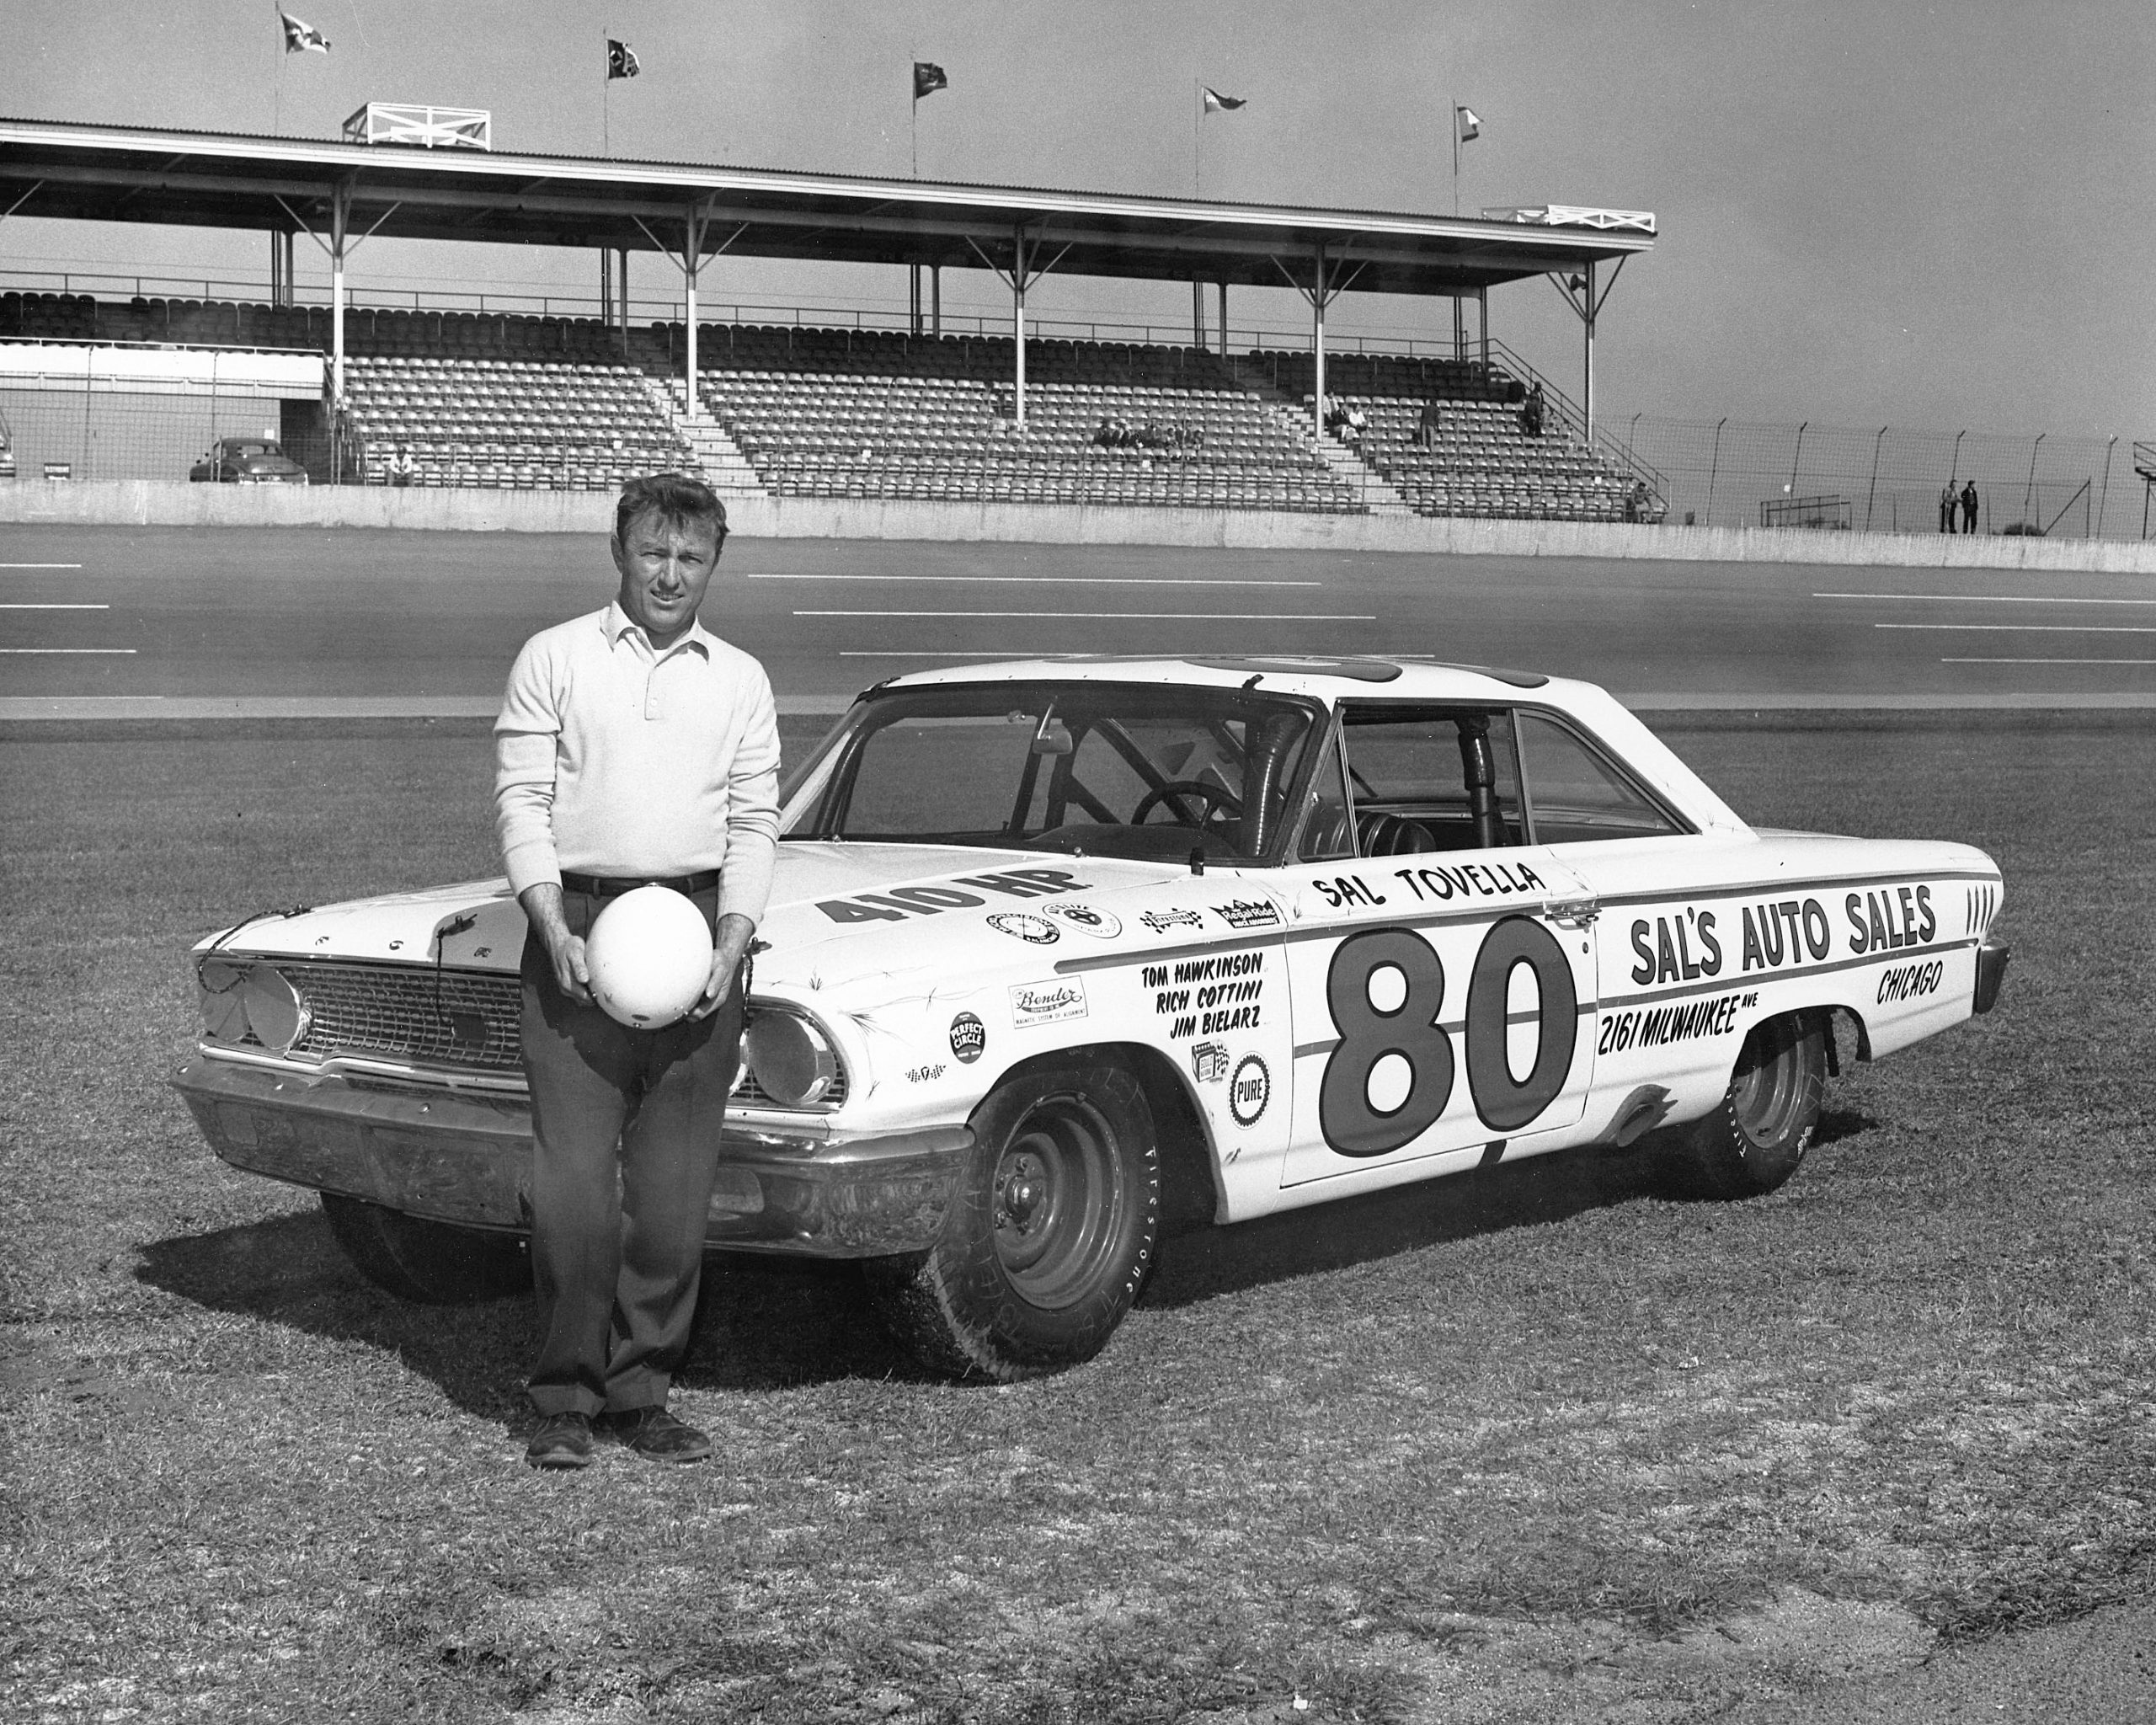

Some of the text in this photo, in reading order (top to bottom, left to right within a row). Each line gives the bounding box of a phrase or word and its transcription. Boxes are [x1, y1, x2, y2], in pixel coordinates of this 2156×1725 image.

[1312, 862, 1547, 908] SAL TOVELLA
[814, 886, 986, 923] 410
[1630, 884, 1936, 985] SAL'S AUTO SALES
[1141, 951, 1263, 989] TOM HAWKINSON
[1876, 959, 1944, 1005] CHICAGO
[1155, 979, 1263, 1015] RICH COTTINI
[949, 1023, 984, 1040] PERFECT
[953, 1033, 982, 1049] CIRCLE
[1170, 1005, 1261, 1039] JIM BIELARZ
[1319, 913, 1578, 1158] 80
[1598, 991, 1759, 1055] 2161 MILWAUKEE AVE
[1236, 1078, 1263, 1103] PURE
[1126, 1146, 1159, 1293] Firestone
